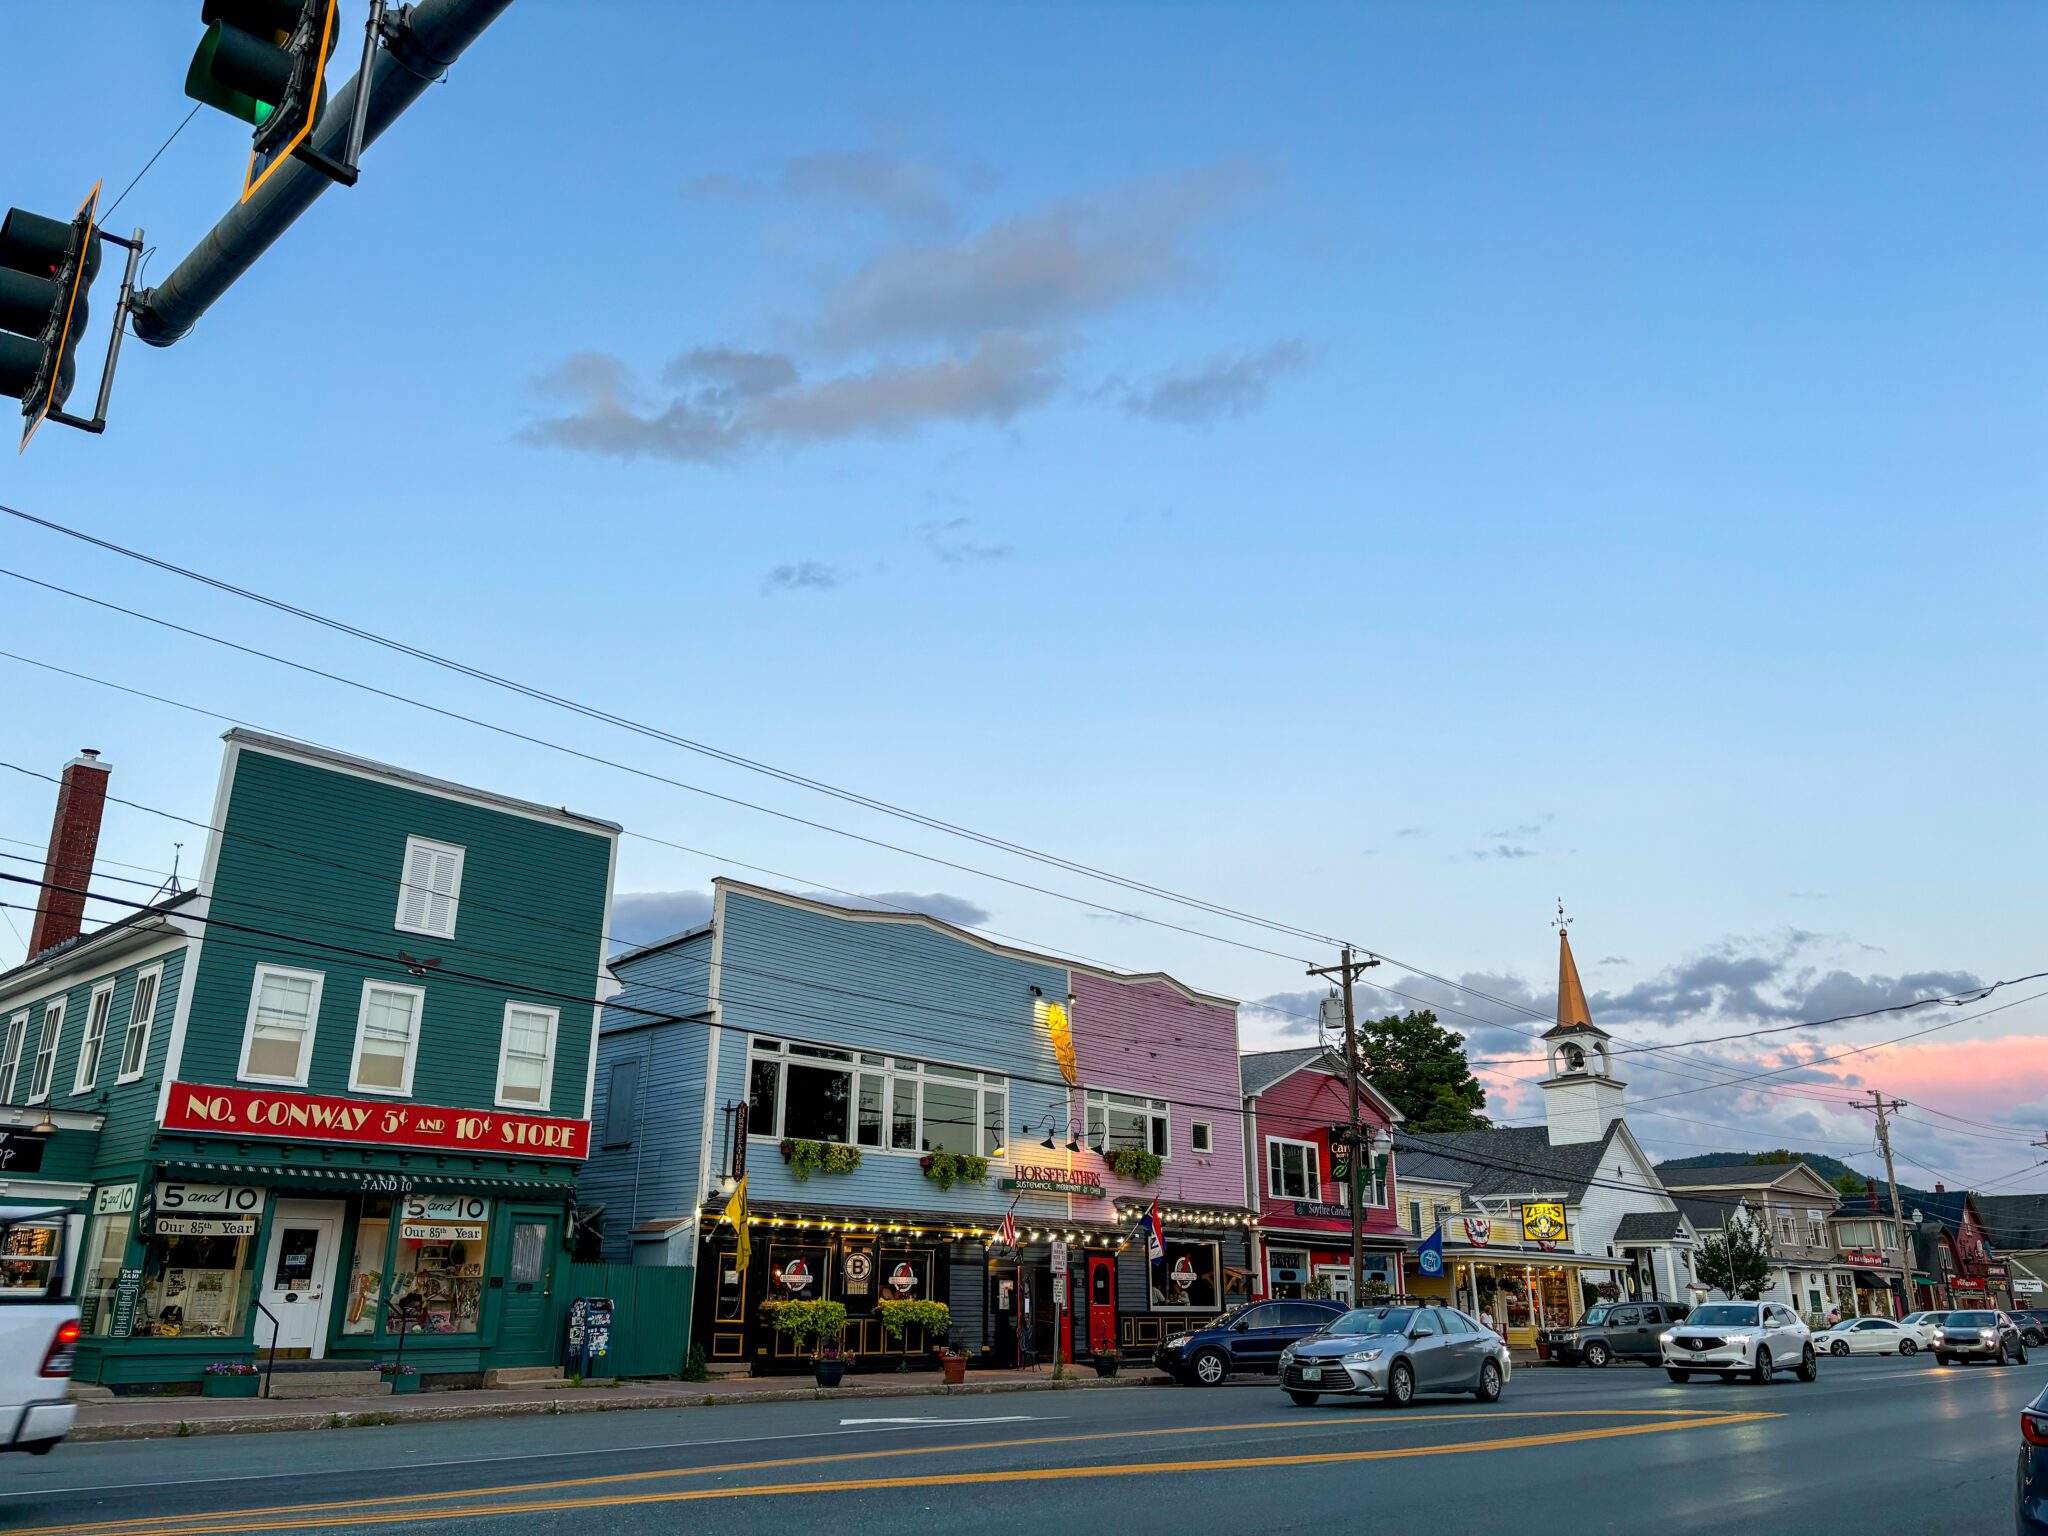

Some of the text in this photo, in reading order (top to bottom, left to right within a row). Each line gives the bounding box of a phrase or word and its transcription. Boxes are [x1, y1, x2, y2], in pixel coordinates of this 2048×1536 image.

[186, 1094, 236, 1122] NO.
[247, 1100, 372, 1131] CONWAY
[415, 1118, 445, 1133] AND
[501, 1122, 576, 1149] STORE
[1015, 1165, 1100, 1187] HORSEFEATHERS
[361, 1181, 412, 1192] 5 AND 10
[100, 1187, 133, 1211] 5 and 10
[162, 1186, 257, 1209] 5 and 10
[407, 1196, 484, 1219] 5 and 10
[1525, 1206, 1561, 1218] ZEB'S
[158, 1221, 185, 1233] Our
[221, 1223, 252, 1234] Year
[404, 1226, 425, 1238] Our
[454, 1228, 480, 1239] Year
[853, 1259, 864, 1274] B
